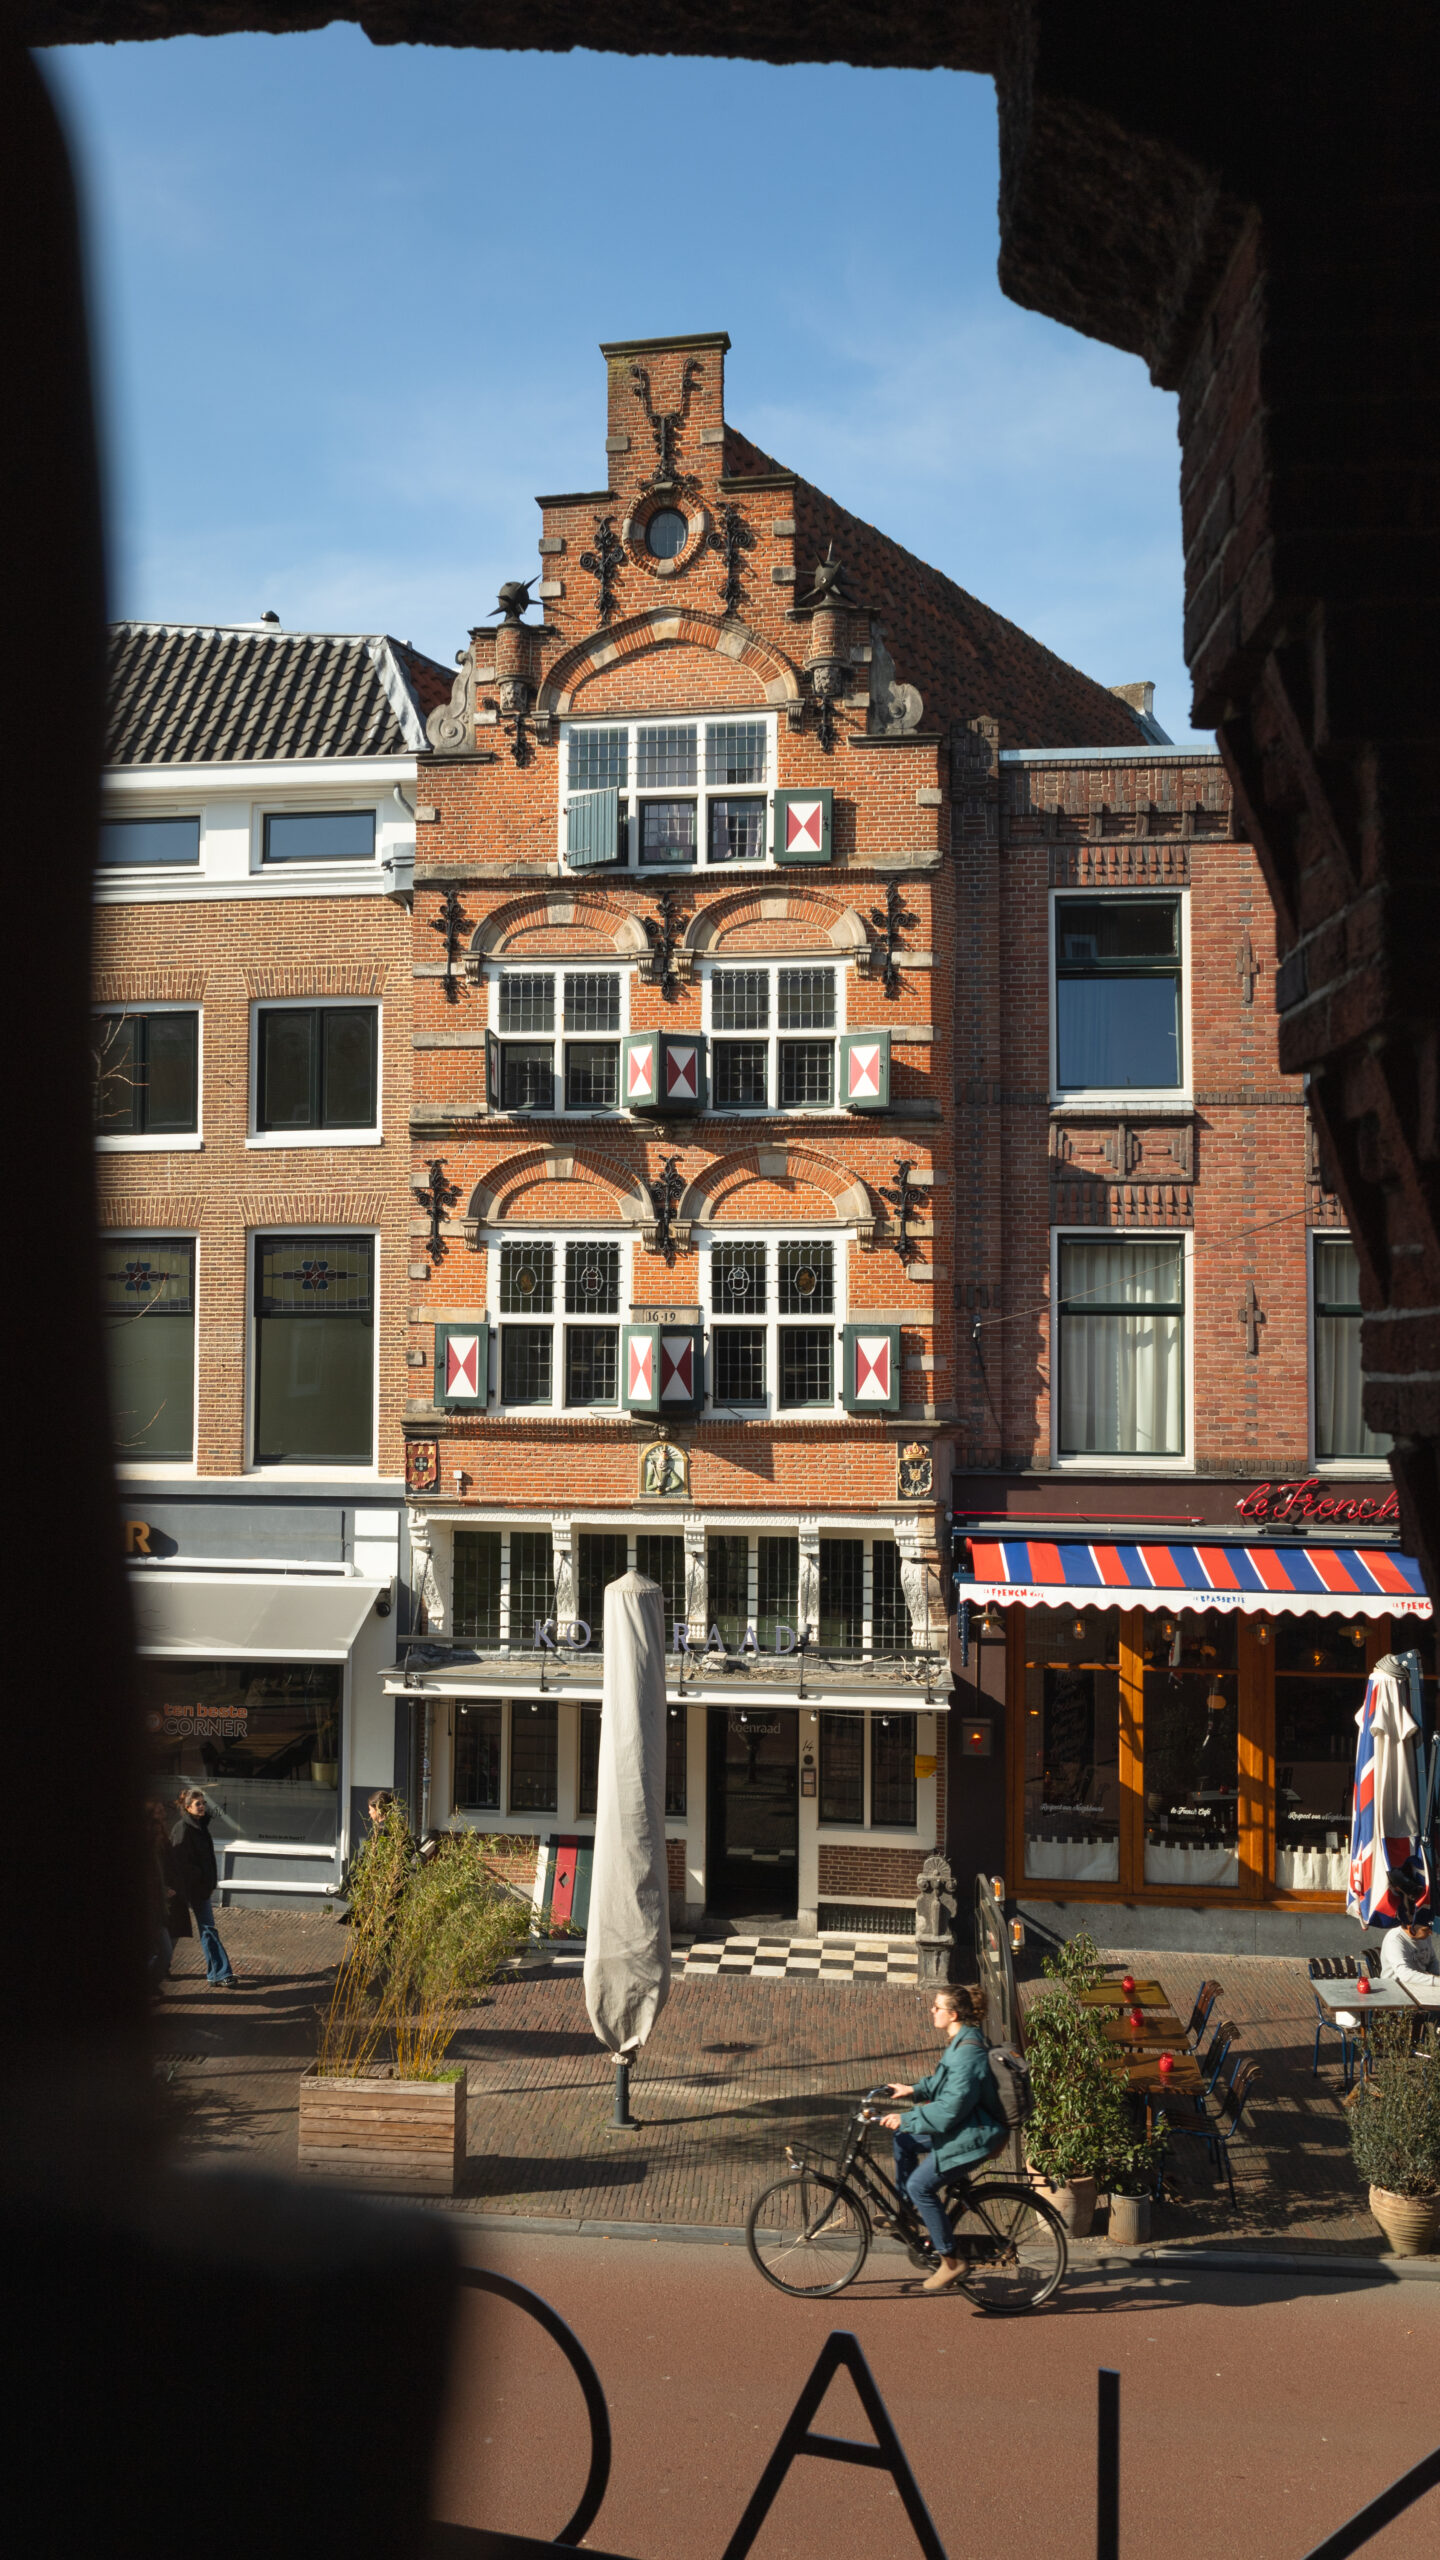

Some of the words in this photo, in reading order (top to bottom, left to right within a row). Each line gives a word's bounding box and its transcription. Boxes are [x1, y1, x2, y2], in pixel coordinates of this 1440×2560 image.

[991, 1588, 1028, 1598] FRENCH
[1200, 1594, 1246, 1604] BRASSERIE
[1400, 1601, 1432, 1611] FRENC
[534, 1619, 796, 1655] KORAAD
[163, 1703, 195, 1717] ten
[196, 1702, 248, 1719] beste
[163, 1717, 248, 1738] CORNER
[727, 1721, 781, 1734] Koenraad
